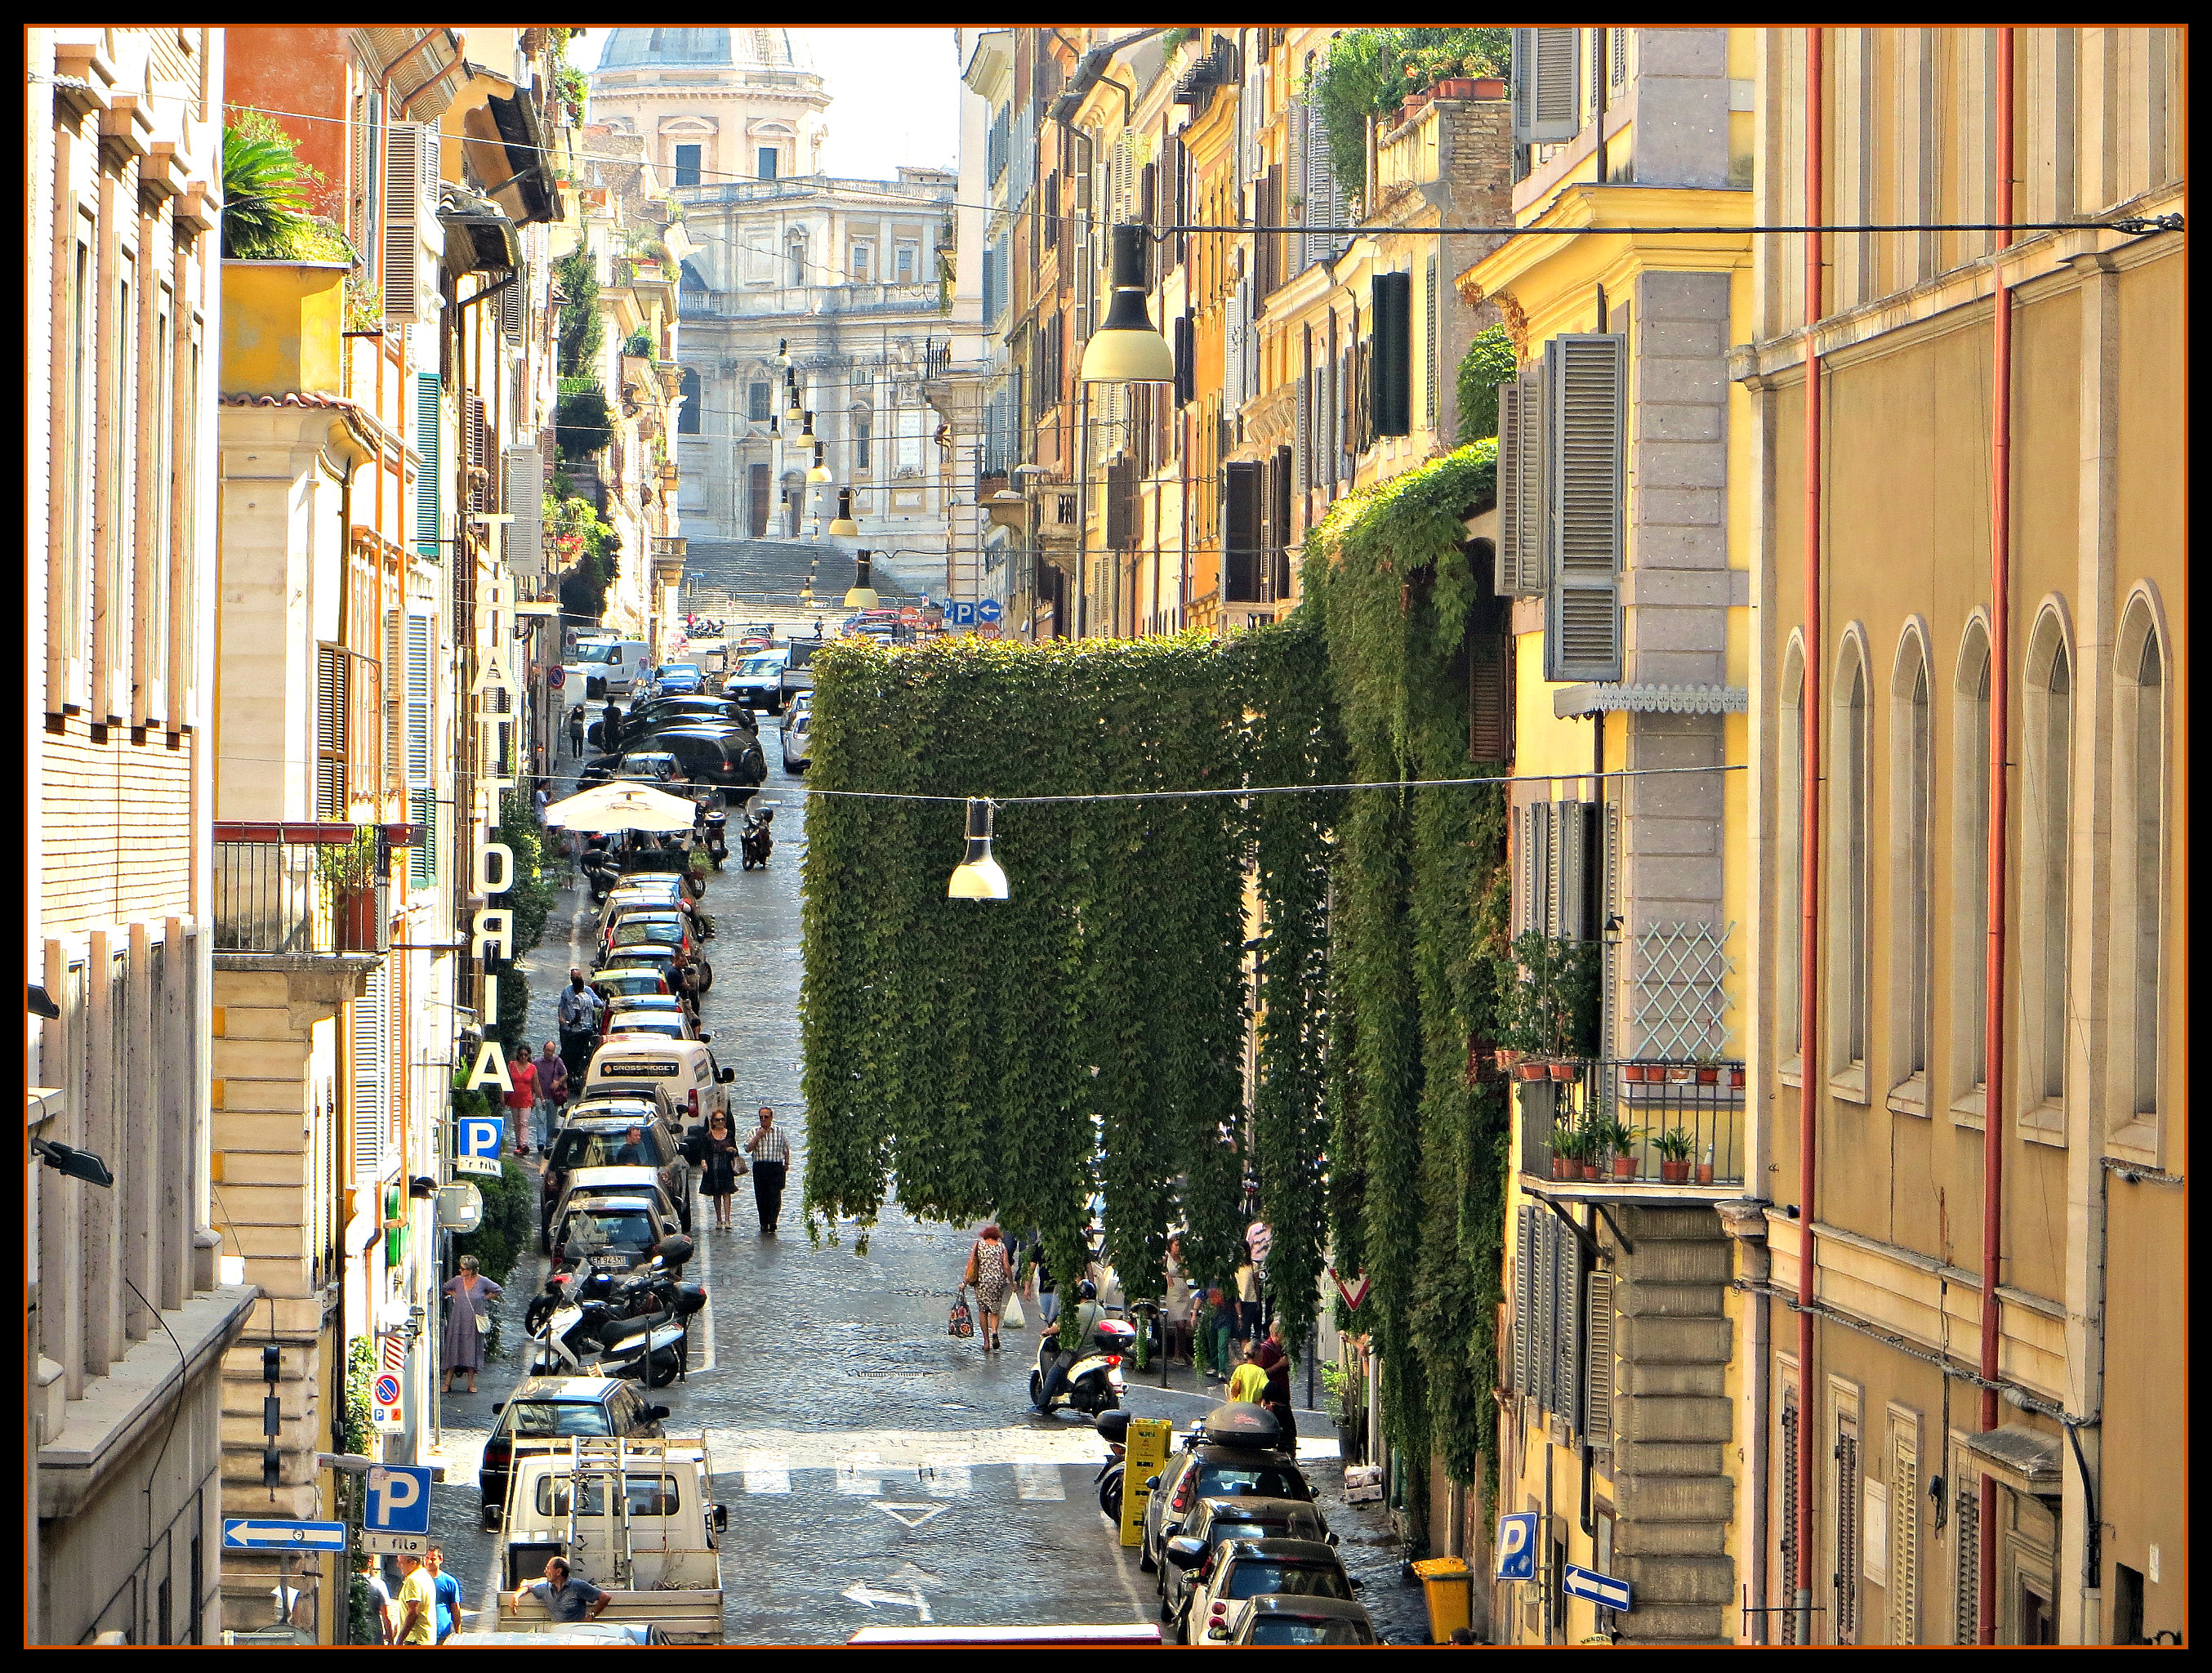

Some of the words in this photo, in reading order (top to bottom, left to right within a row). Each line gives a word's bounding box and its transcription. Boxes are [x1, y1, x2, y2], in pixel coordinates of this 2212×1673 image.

[957, 605, 971, 622] P
[468, 1122, 497, 1157] P
[376, 1409, 383, 1421] P
[377, 1472, 420, 1526] P
[1497, 1519, 1527, 1573] P
